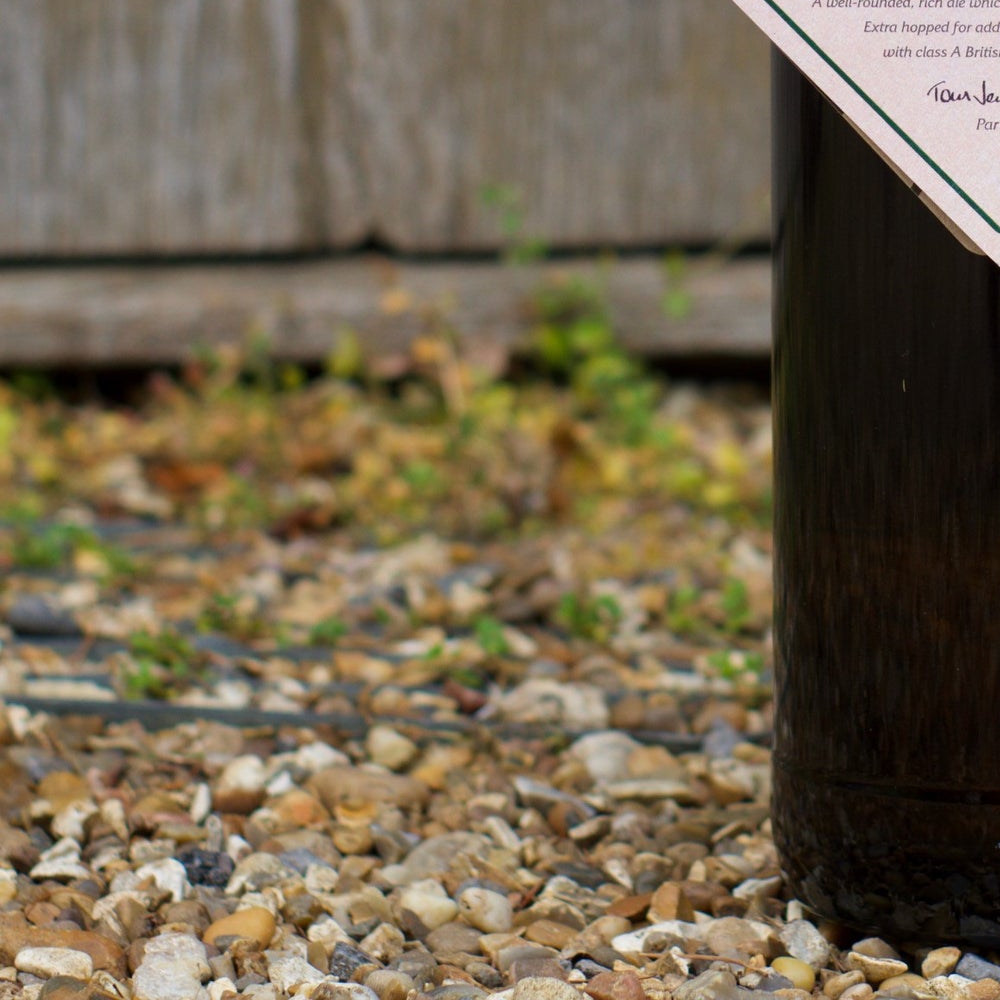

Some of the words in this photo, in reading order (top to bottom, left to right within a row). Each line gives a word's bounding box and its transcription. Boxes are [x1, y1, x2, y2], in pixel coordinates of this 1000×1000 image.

[863, 20, 898, 33] Extra
[901, 21, 949, 36] hopped
[950, 21, 972, 36] for
[883, 46, 912, 58] with
[916, 46, 947, 58] class
[950, 46, 961, 58] A
